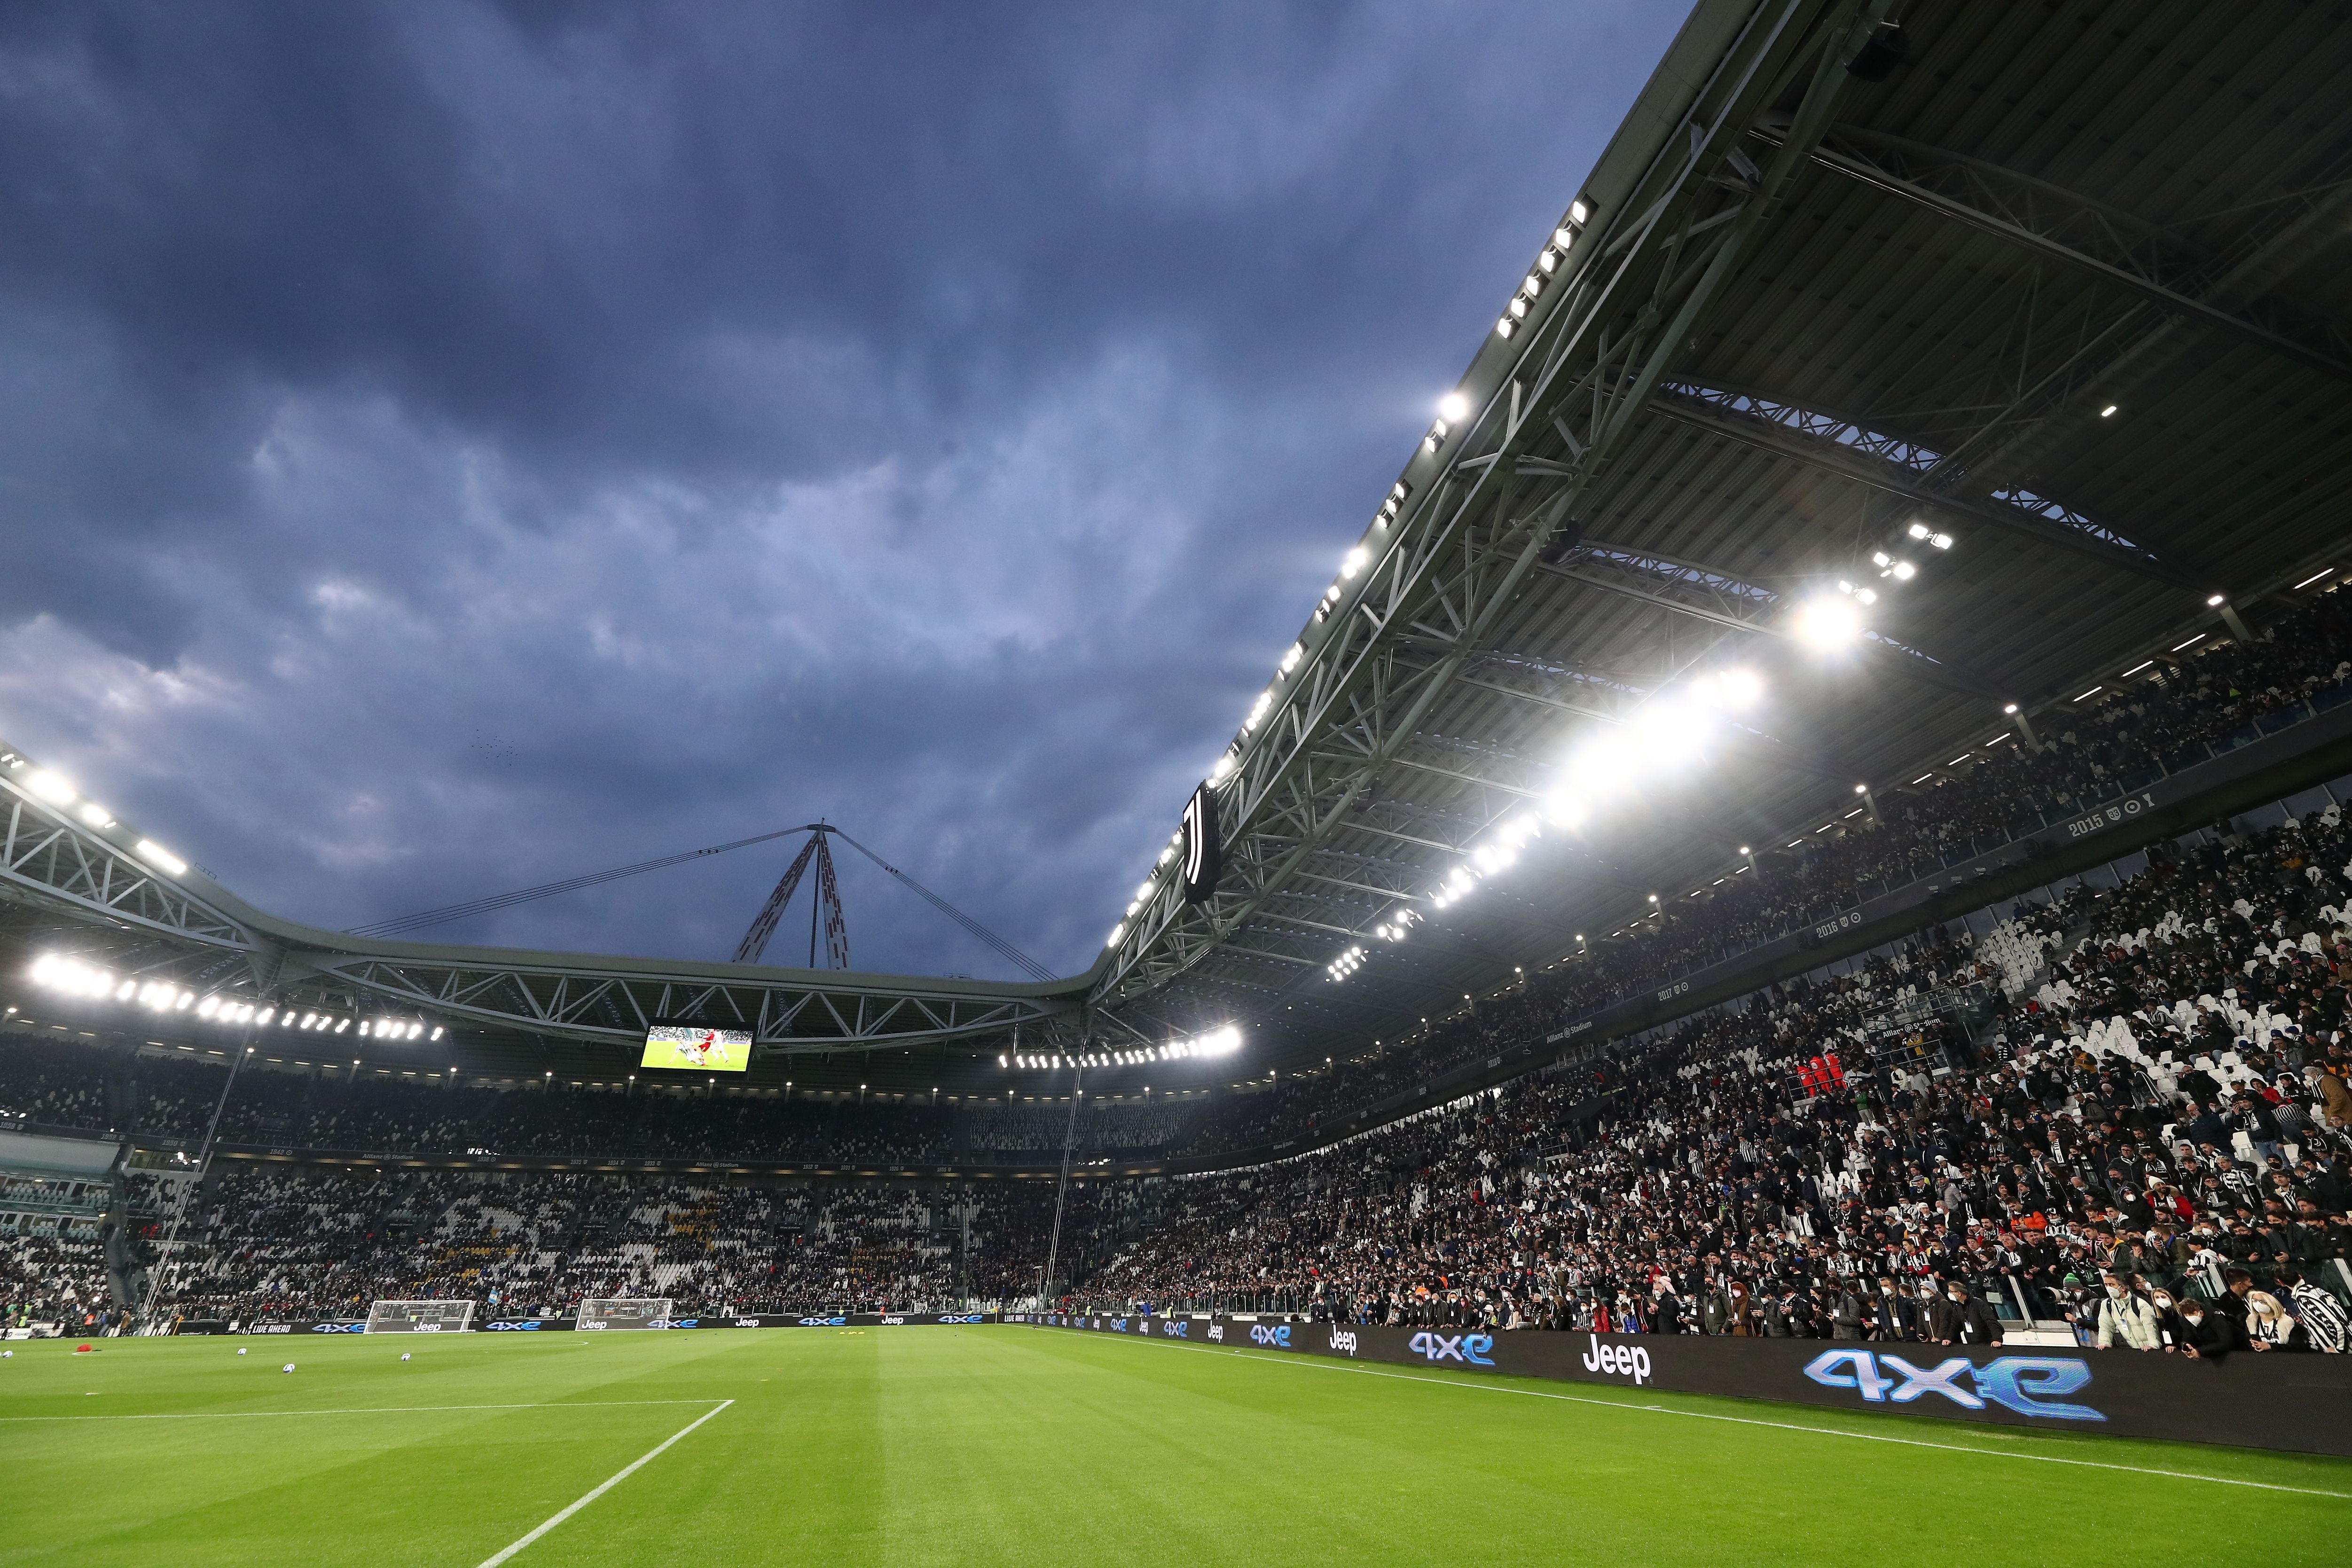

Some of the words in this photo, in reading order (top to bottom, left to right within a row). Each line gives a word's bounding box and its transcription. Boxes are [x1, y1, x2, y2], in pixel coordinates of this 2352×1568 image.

[2109, 809, 2120, 818] 33
[2069, 814, 2104, 837] 2015
[1816, 921, 1838, 938] 2016
[1658, 988, 1672, 1001] 2017
[1547, 1032, 1564, 1044] Allianz
[1570, 1021, 1592, 1034] Stadium
[1488, 1058, 1497, 1068] 2018
[414, 1322, 441, 1332] Jeep
[581, 1319, 607, 1330] Jeep
[735, 1317, 760, 1327] Jeep
[881, 1316, 904, 1325] Jeep
[1139, 1317, 1148, 1335] Jeep
[252, 1325, 267, 1333] LIVE
[267, 1325, 291, 1333] AHEAD
[1207, 1320, 1223, 1343] Jeep
[1329, 1325, 1357, 1356] Jeep
[1582, 1333, 1651, 1384] Jeep
